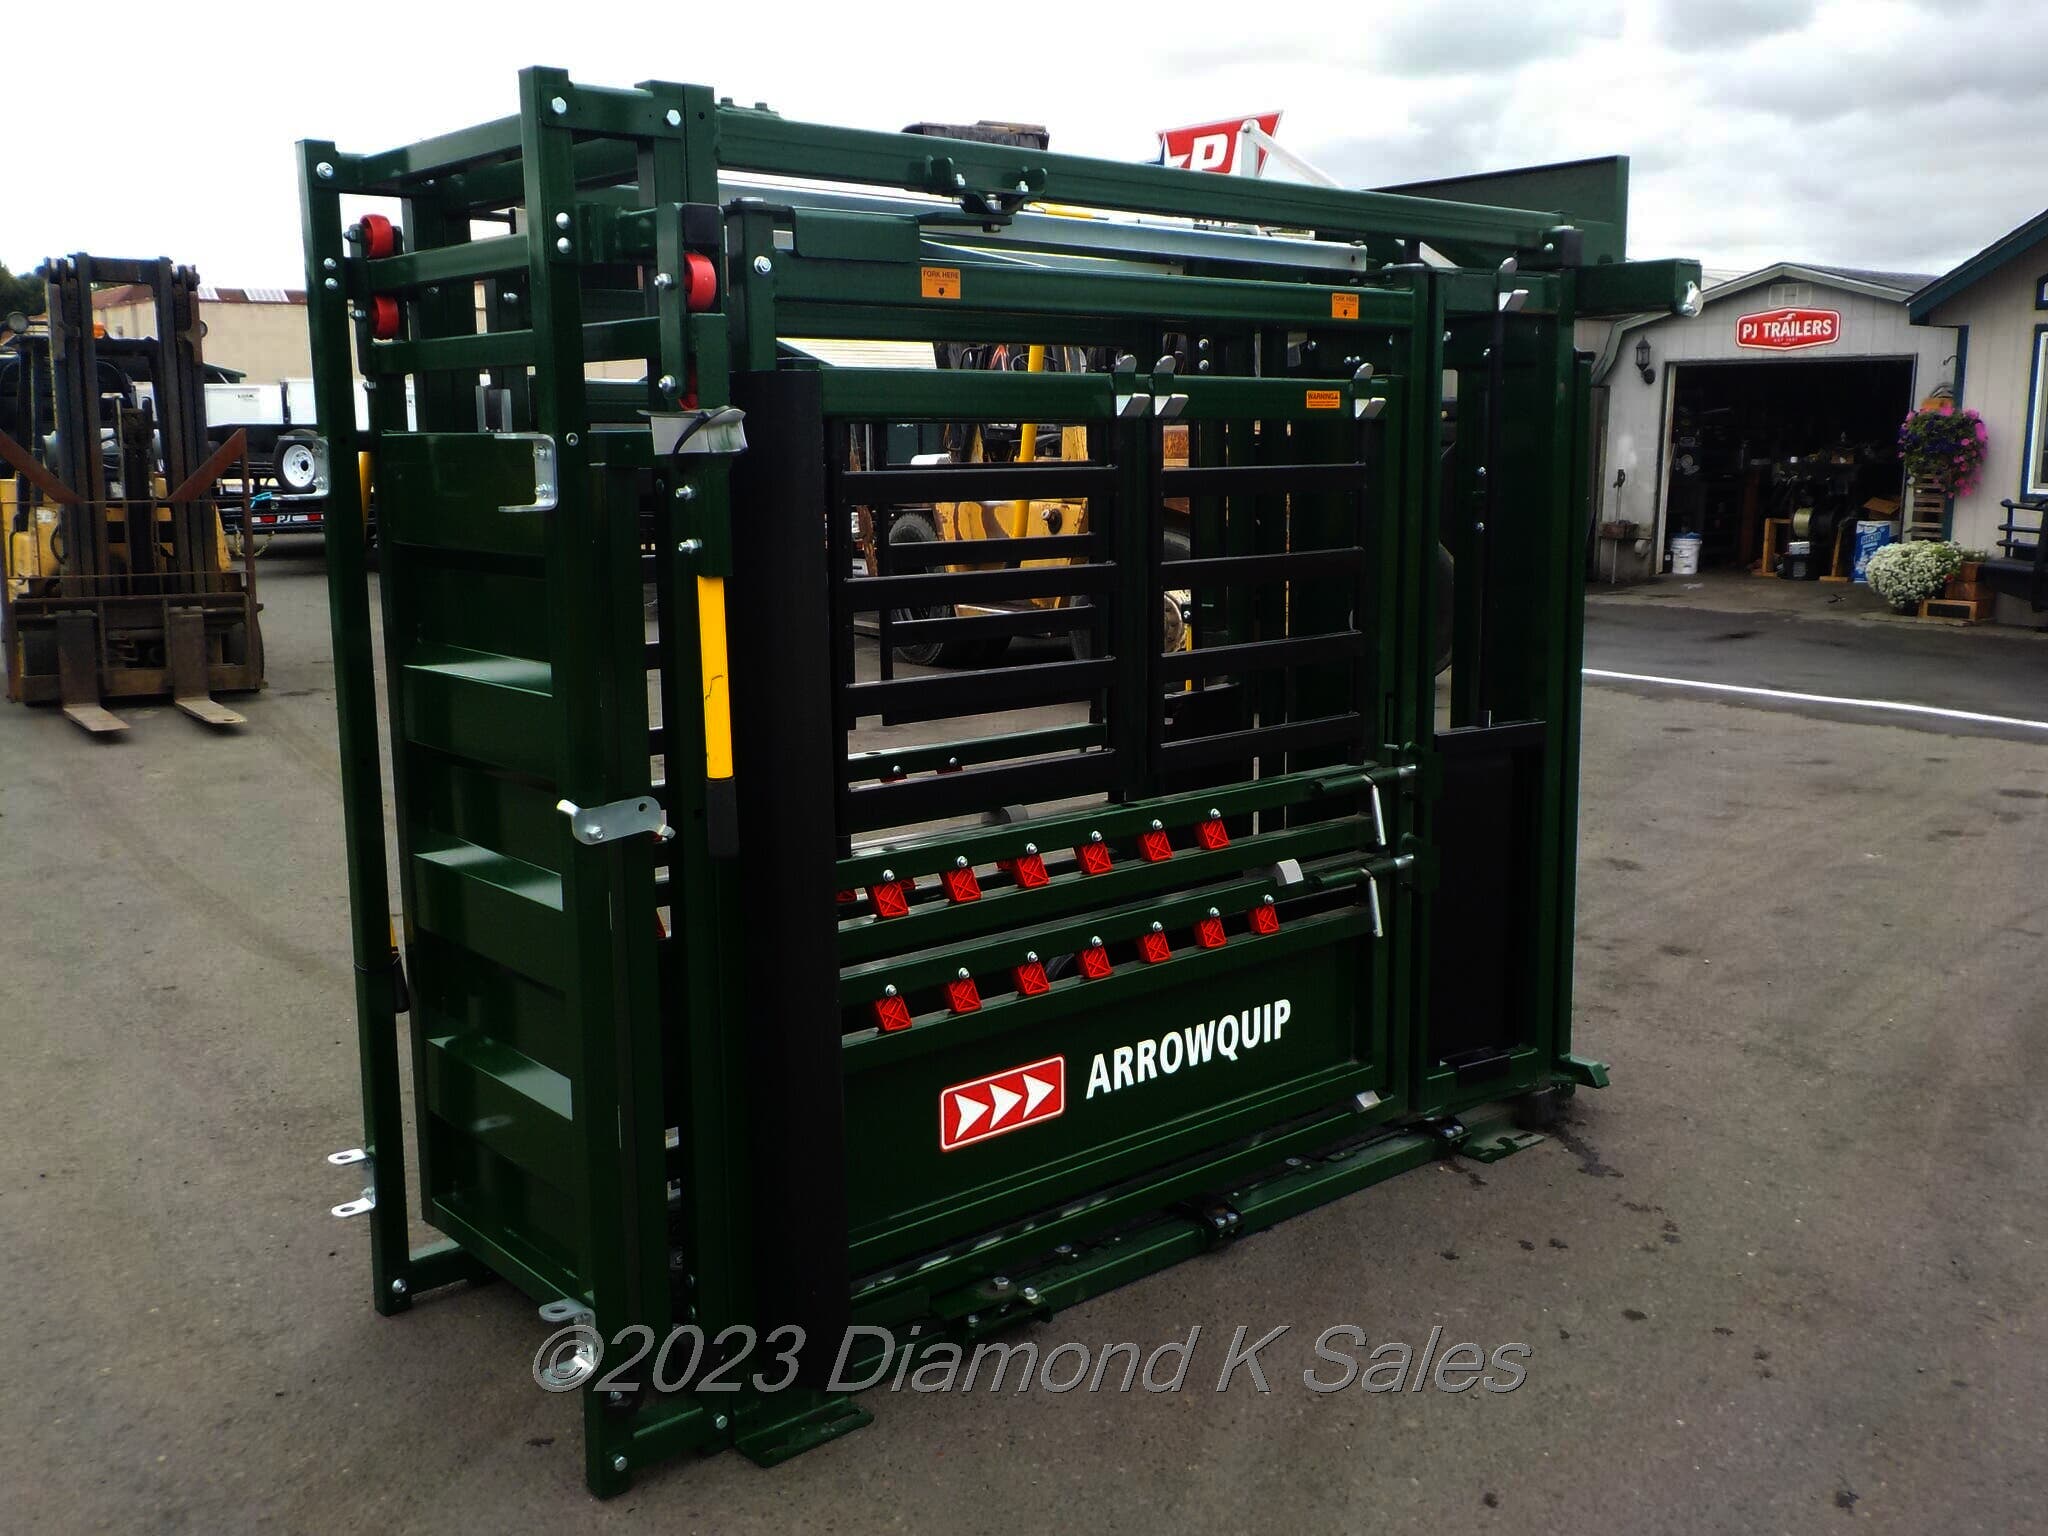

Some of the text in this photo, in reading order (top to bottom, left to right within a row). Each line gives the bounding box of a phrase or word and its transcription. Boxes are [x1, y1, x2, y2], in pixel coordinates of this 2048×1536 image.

[923, 269, 959, 280] FORK HERE
[1742, 319, 1833, 339] PJ TRAILERS
[1308, 391, 1334, 400] WARNING
[276, 514, 291, 524] PJ
[1086, 999, 1291, 1100] ARROWQUIP
